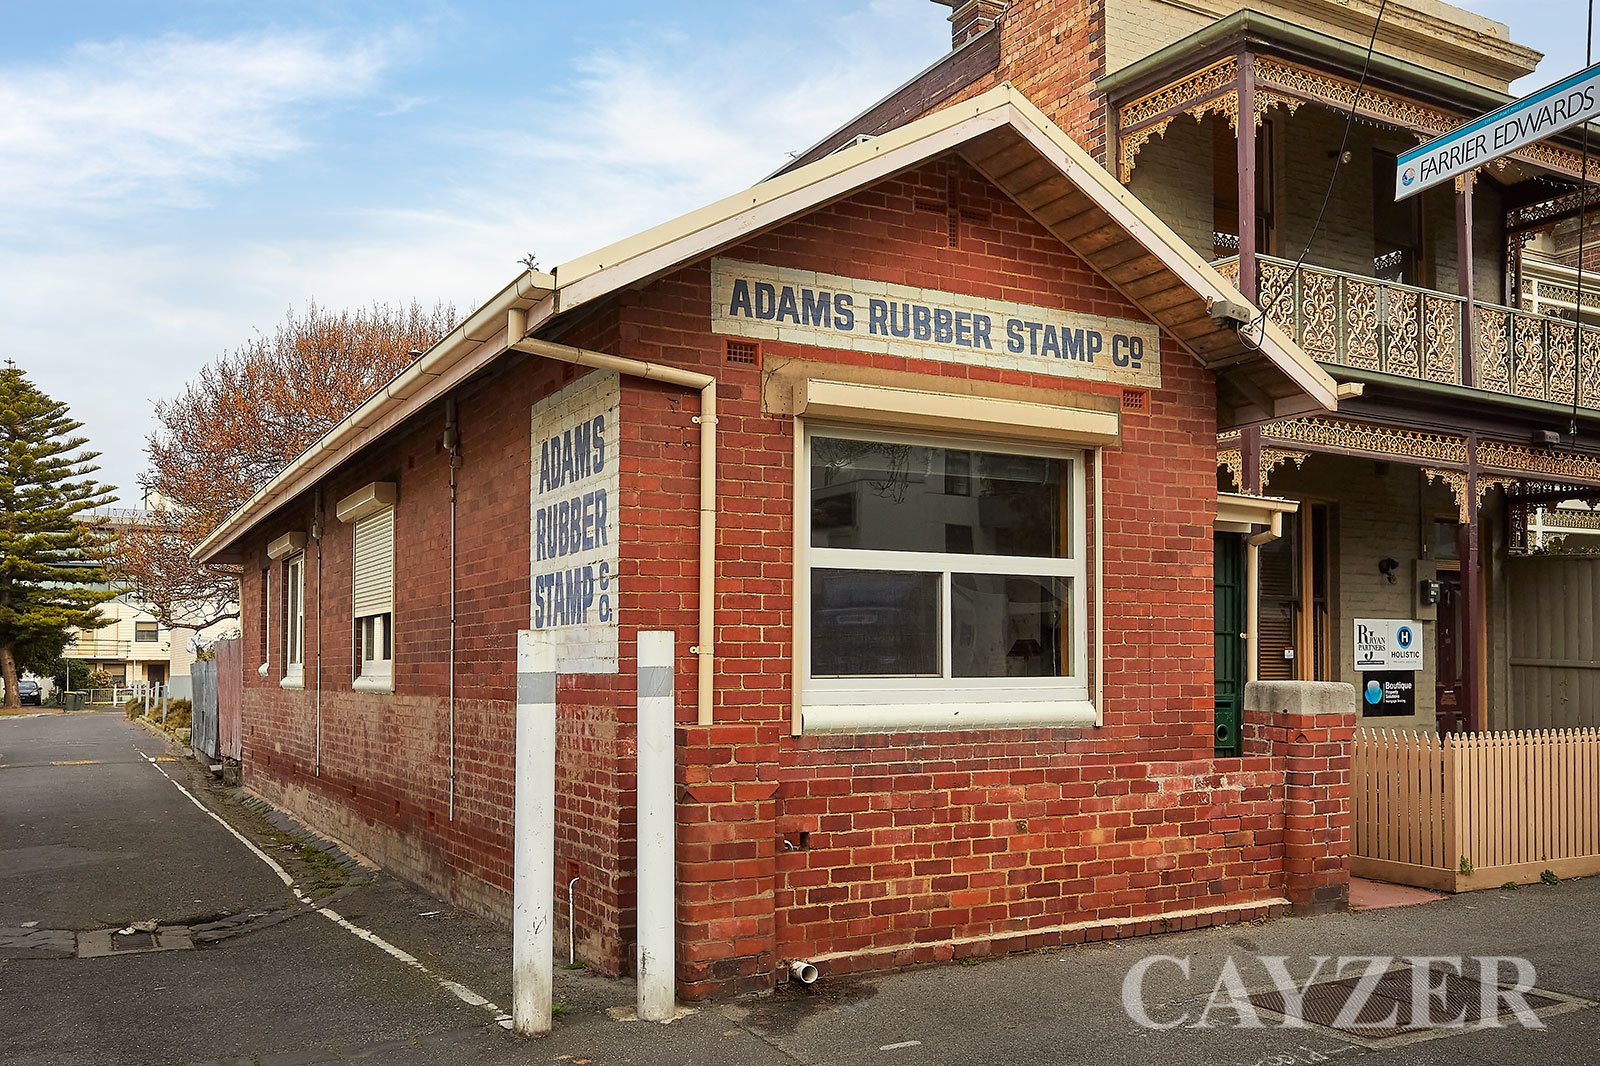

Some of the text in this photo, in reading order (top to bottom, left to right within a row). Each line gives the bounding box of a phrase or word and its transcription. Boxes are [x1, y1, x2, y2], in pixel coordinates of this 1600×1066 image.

[1420, 85, 1595, 183] FARRIER EDWARDS
[729, 278, 855, 331] ADAMS
[869, 298, 992, 351] RUBBER
[1006, 318, 1103, 364] STAMP
[538, 414, 606, 495] ADAMS
[536, 488, 608, 562] RUBBER
[535, 565, 594, 629] STAMP
[1391, 651, 1420, 659] HOLISTIC
[1401, 631, 1409, 643] H
[1385, 681, 1413, 691] Boutique
